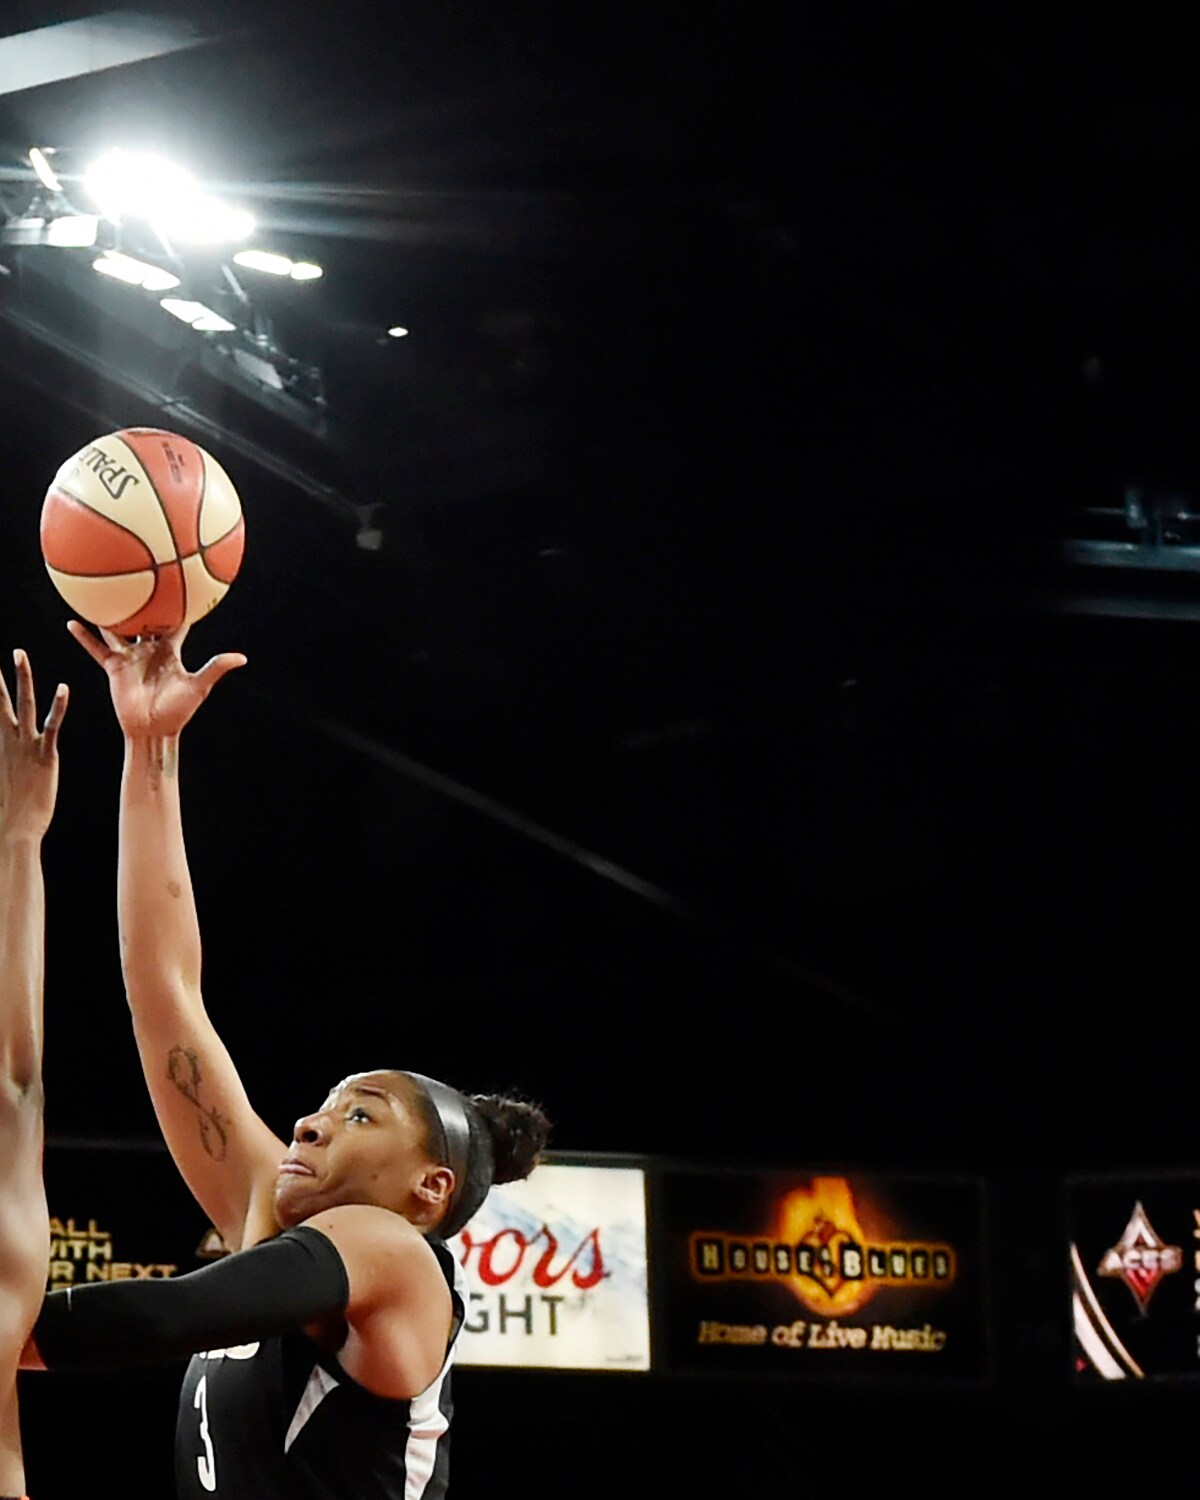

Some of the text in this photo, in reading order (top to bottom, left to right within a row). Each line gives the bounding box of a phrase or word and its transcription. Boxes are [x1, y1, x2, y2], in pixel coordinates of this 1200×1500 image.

[85, 1261, 179, 1282] NEXT
[460, 1222, 612, 1290] ors
[463, 1292, 566, 1336] GHT
[771, 1320, 805, 1347] of
[807, 1320, 868, 1349] Live
[870, 1323, 947, 1351] Music
